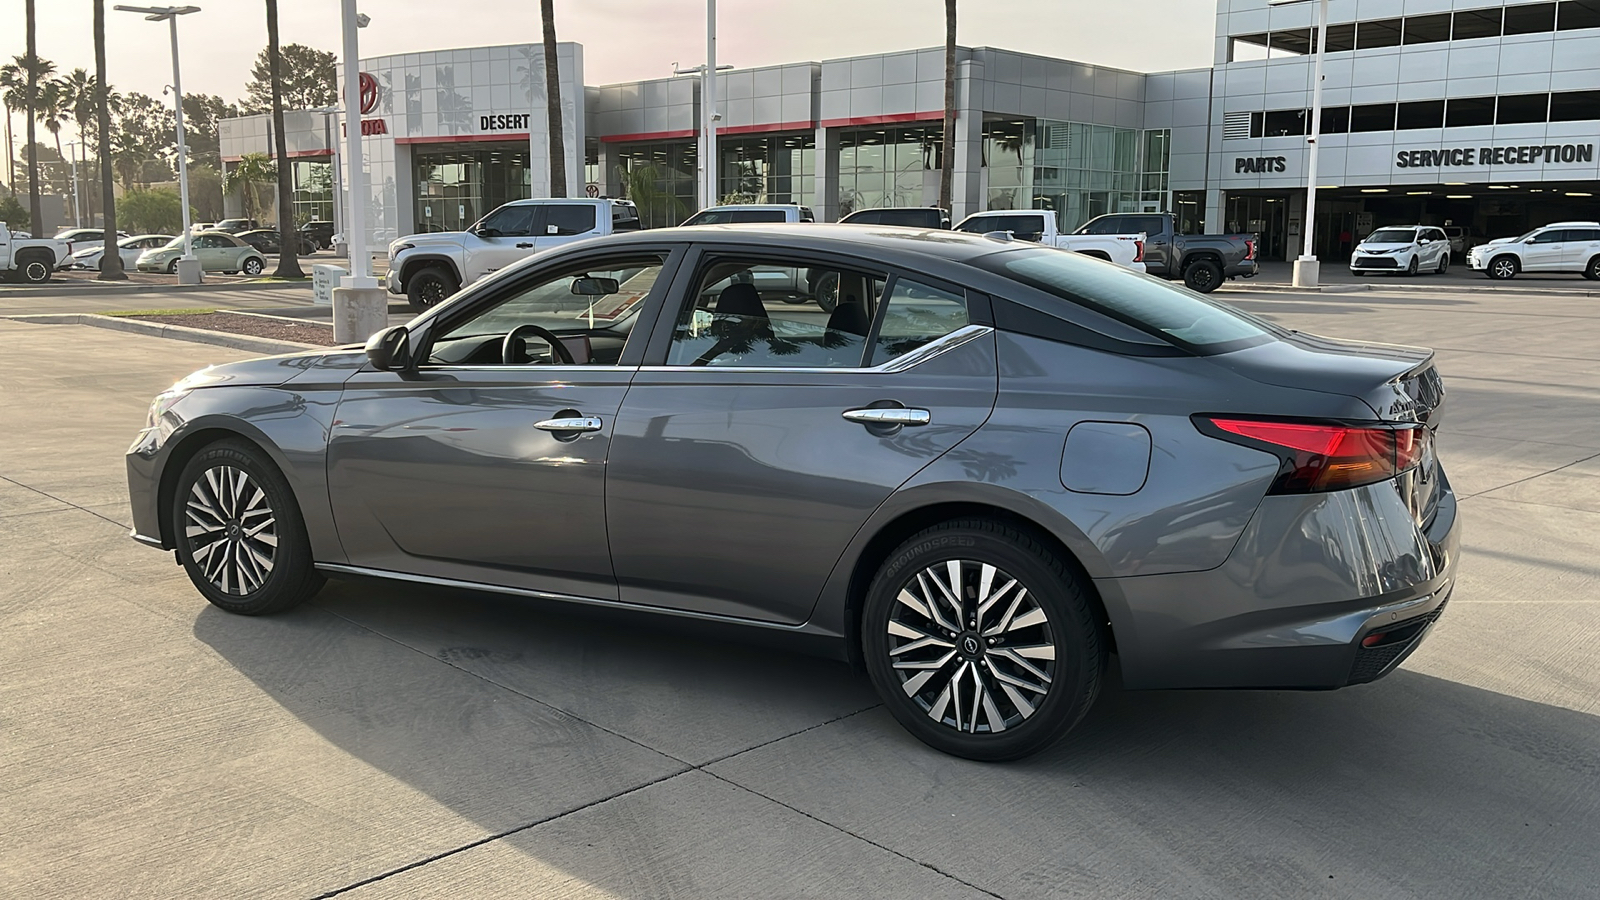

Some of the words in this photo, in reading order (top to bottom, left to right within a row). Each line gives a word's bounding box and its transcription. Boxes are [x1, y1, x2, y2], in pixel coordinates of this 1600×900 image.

[341, 119, 389, 137] TOTA
[480, 114, 531, 131] DESERT
[1234, 156, 1287, 173] PARTS
[1396, 148, 1475, 168] SERVICE
[1479, 144, 1593, 165] RECEPTION
[886, 536, 976, 578] GROUNDSPEED
